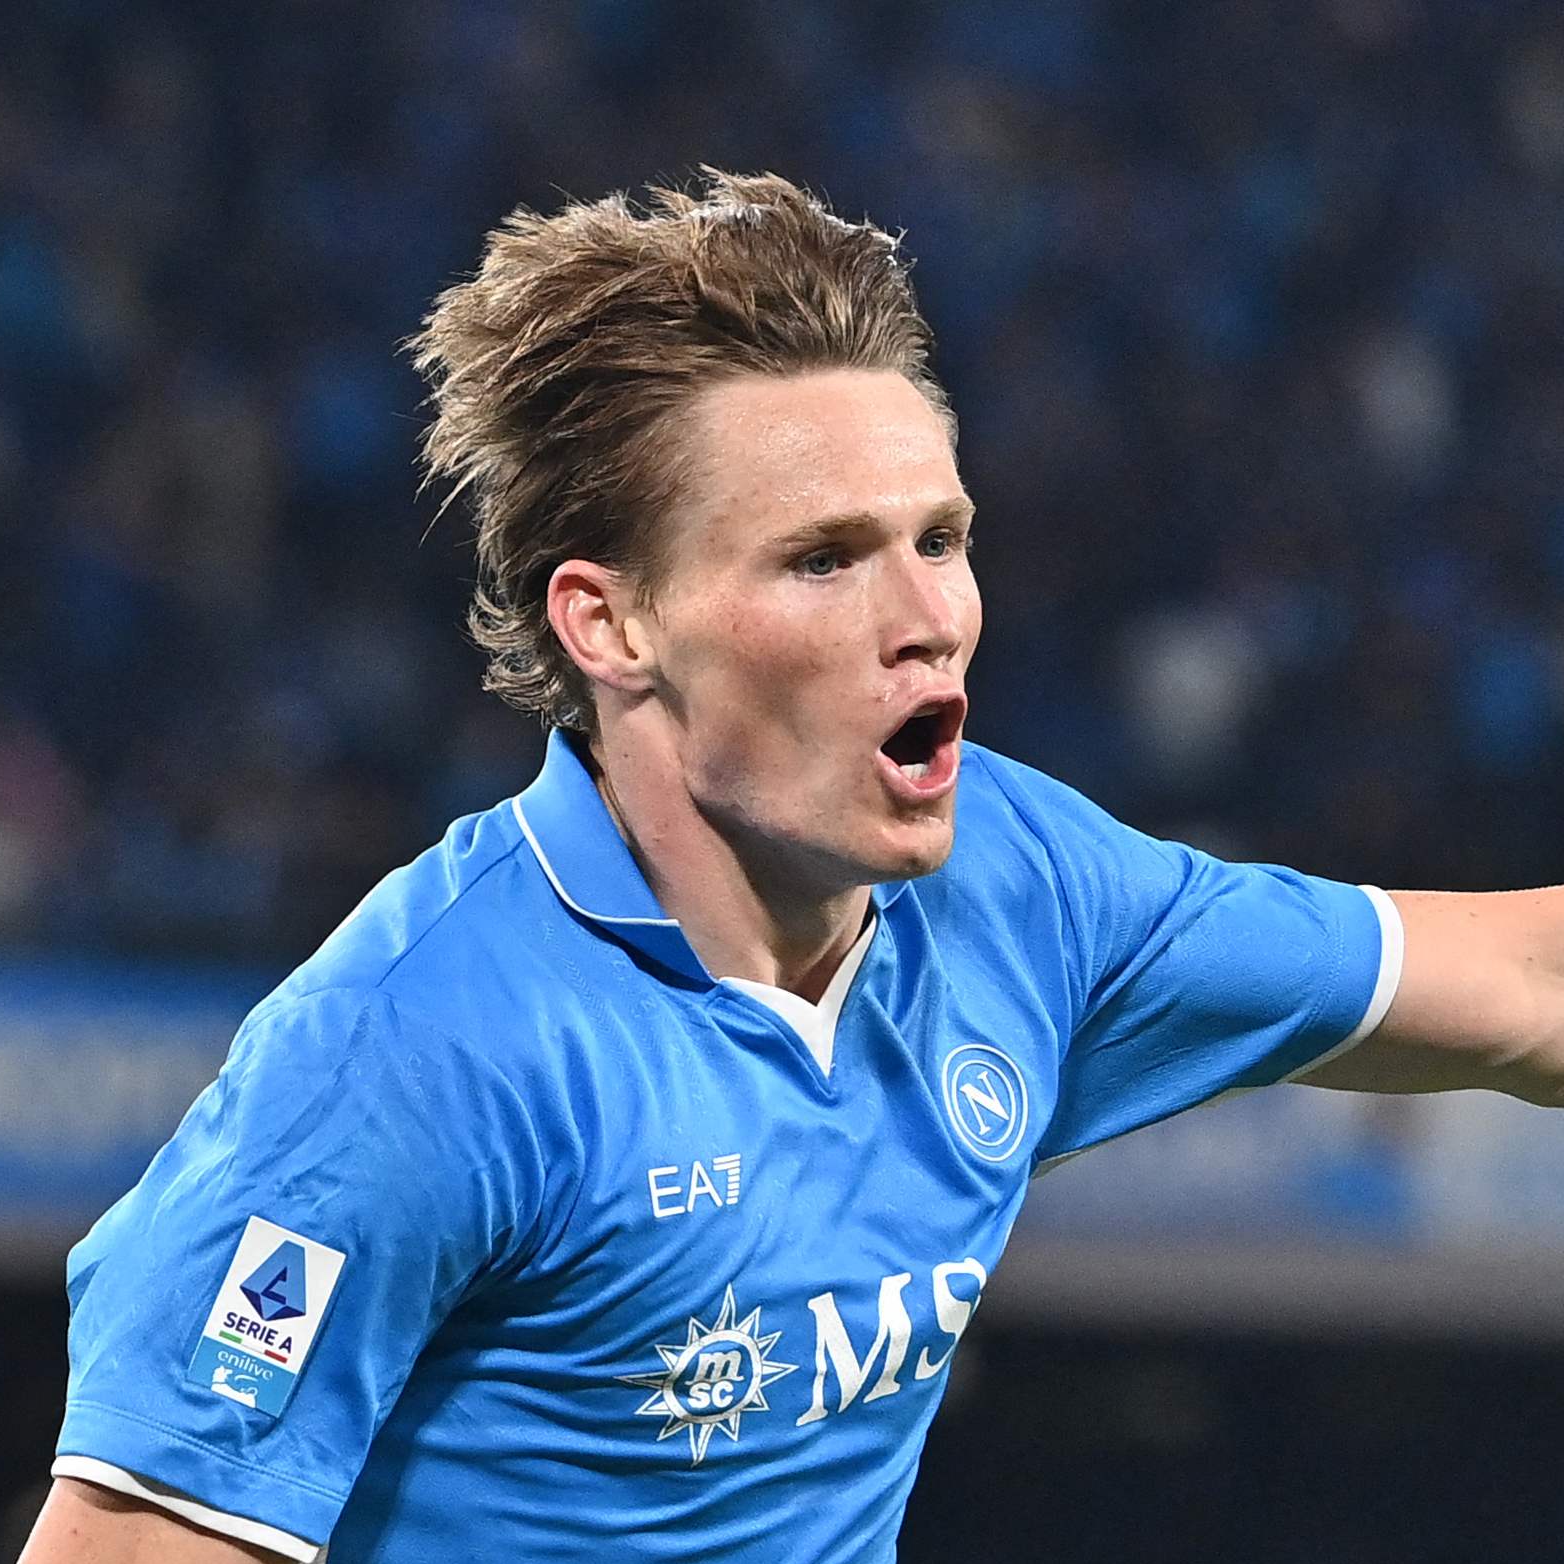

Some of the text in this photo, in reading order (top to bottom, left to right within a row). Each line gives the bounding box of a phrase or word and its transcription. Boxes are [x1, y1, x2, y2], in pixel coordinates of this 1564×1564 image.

[959, 1070, 1010, 1136] N
[648, 1153, 741, 1218] EA7
[223, 1311, 293, 1354] SERIE A
[217, 1350, 274, 1380] enilive
